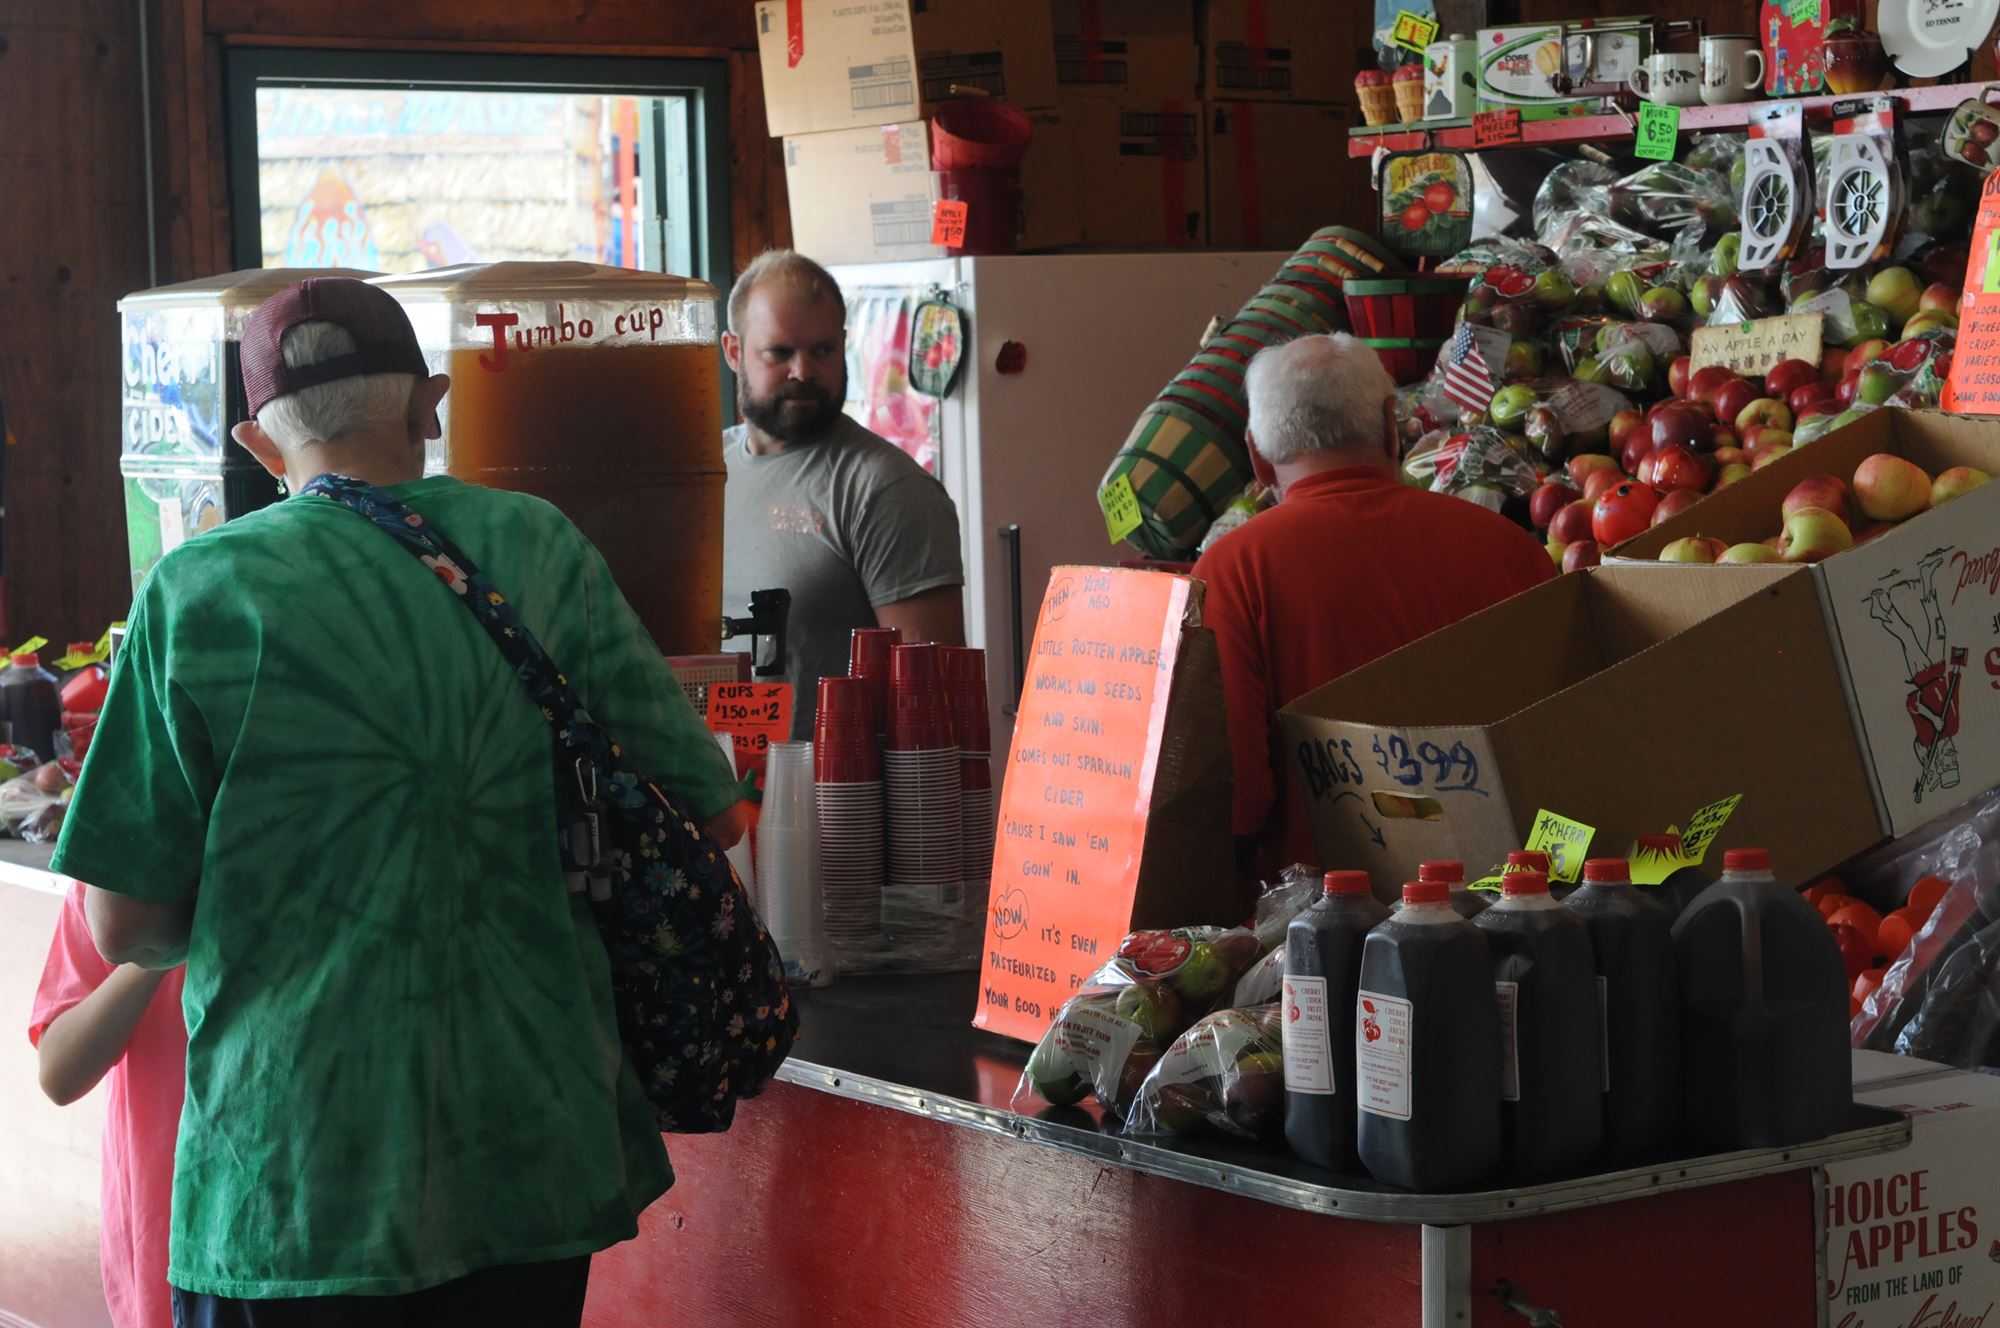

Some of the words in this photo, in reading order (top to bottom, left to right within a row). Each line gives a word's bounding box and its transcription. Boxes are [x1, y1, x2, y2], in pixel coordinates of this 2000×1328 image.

[1505, 54, 1529, 63] CORE
[399, 94, 560, 137] WAVE
[476, 303, 593, 373] Jumbo
[614, 307, 663, 341] cup
[1702, 343, 1719, 355] AN
[1724, 337, 1761, 352] APPLE
[1766, 335, 1776, 346] A
[1782, 331, 1807, 345] DAY
[1037, 639, 1064, 657] LITTLE
[1071, 638, 1116, 660] ROTTEN
[717, 685, 754, 699] CUPS
[1035, 674, 1073, 695] WORMS
[1076, 679, 1097, 696] AND
[1104, 681, 1143, 702] SEEDS
[763, 701, 780, 721] $2
[1043, 711, 1065, 728] AND
[1015, 748, 1047, 766] COMES
[1052, 752, 1071, 767] OUT
[1299, 737, 1364, 801] BAGS
[1044, 785, 1084, 808] CIDER
[1039, 825, 1046, 841] I
[1051, 831, 1077, 848] SAW
[1041, 925, 1061, 946] IT'S
[1070, 934, 1098, 956] EVEN
[990, 951, 1057, 984] PASTEURIZED
[984, 986, 1009, 1011] YOUR
[1015, 996, 1042, 1019] GOOD
[1306, 1005, 1323, 1013] FRUIT
[1384, 1007, 1406, 1018] CHERRY
[1306, 1013, 1324, 1022] DRINK
[1388, 1017, 1406, 1027] CIDER
[1389, 1027, 1406, 1036] FRUIT
[1828, 1206, 1979, 1300] APPLES
[1846, 1283, 1881, 1307] FROM
[1886, 1276, 1909, 1298] THE
[1913, 1268, 1945, 1293] LAND
[1949, 1264, 1965, 1286] OF
